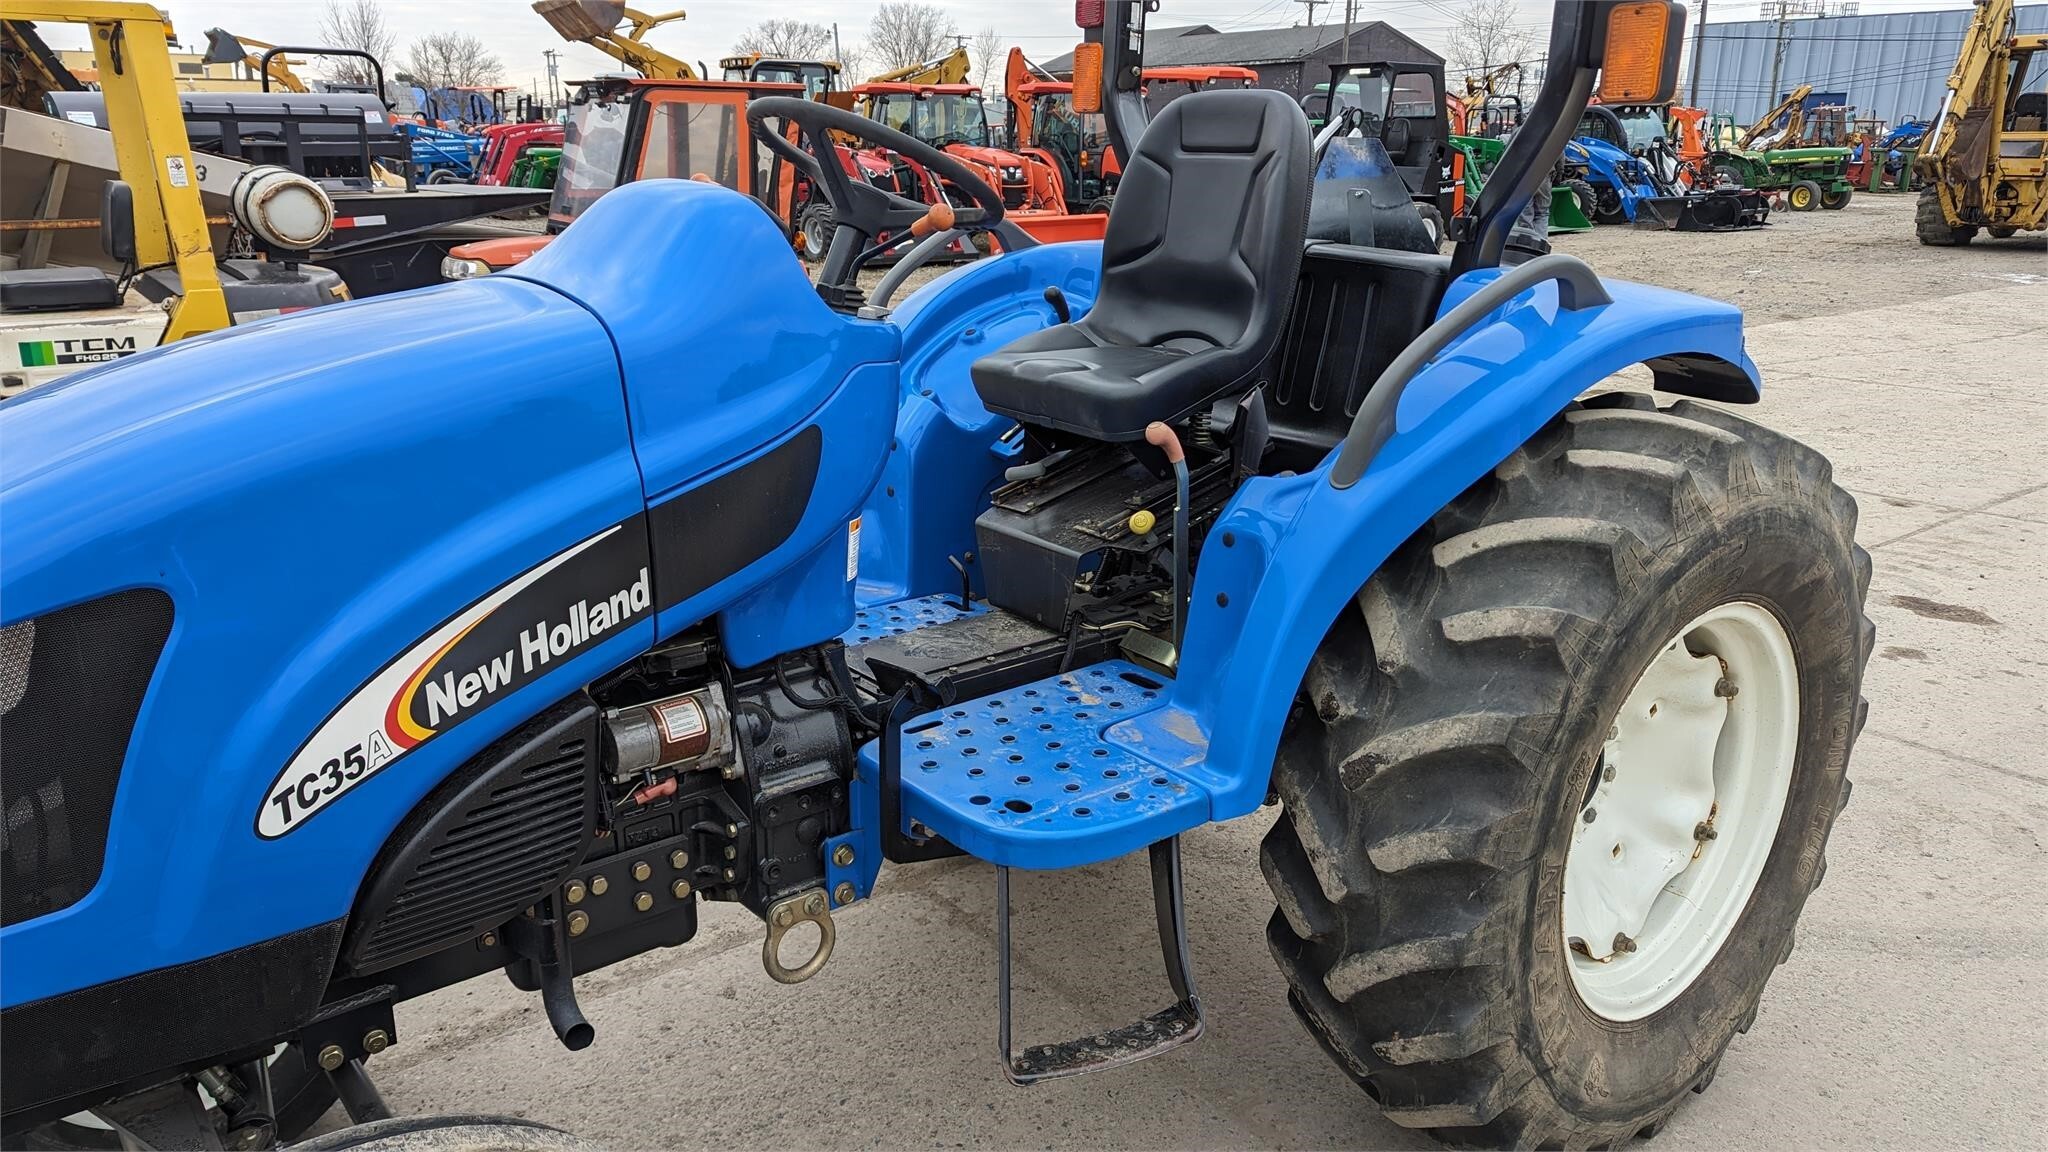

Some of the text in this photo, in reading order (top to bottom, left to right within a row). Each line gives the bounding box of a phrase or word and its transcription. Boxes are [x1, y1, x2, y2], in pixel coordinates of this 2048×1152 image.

[417, 127, 435, 135] FORD
[54, 336, 136, 352] TCM
[424, 567, 651, 728] New Holland
[272, 729, 393, 826] TC35A
[1531, 856, 1576, 1072] TITAN
